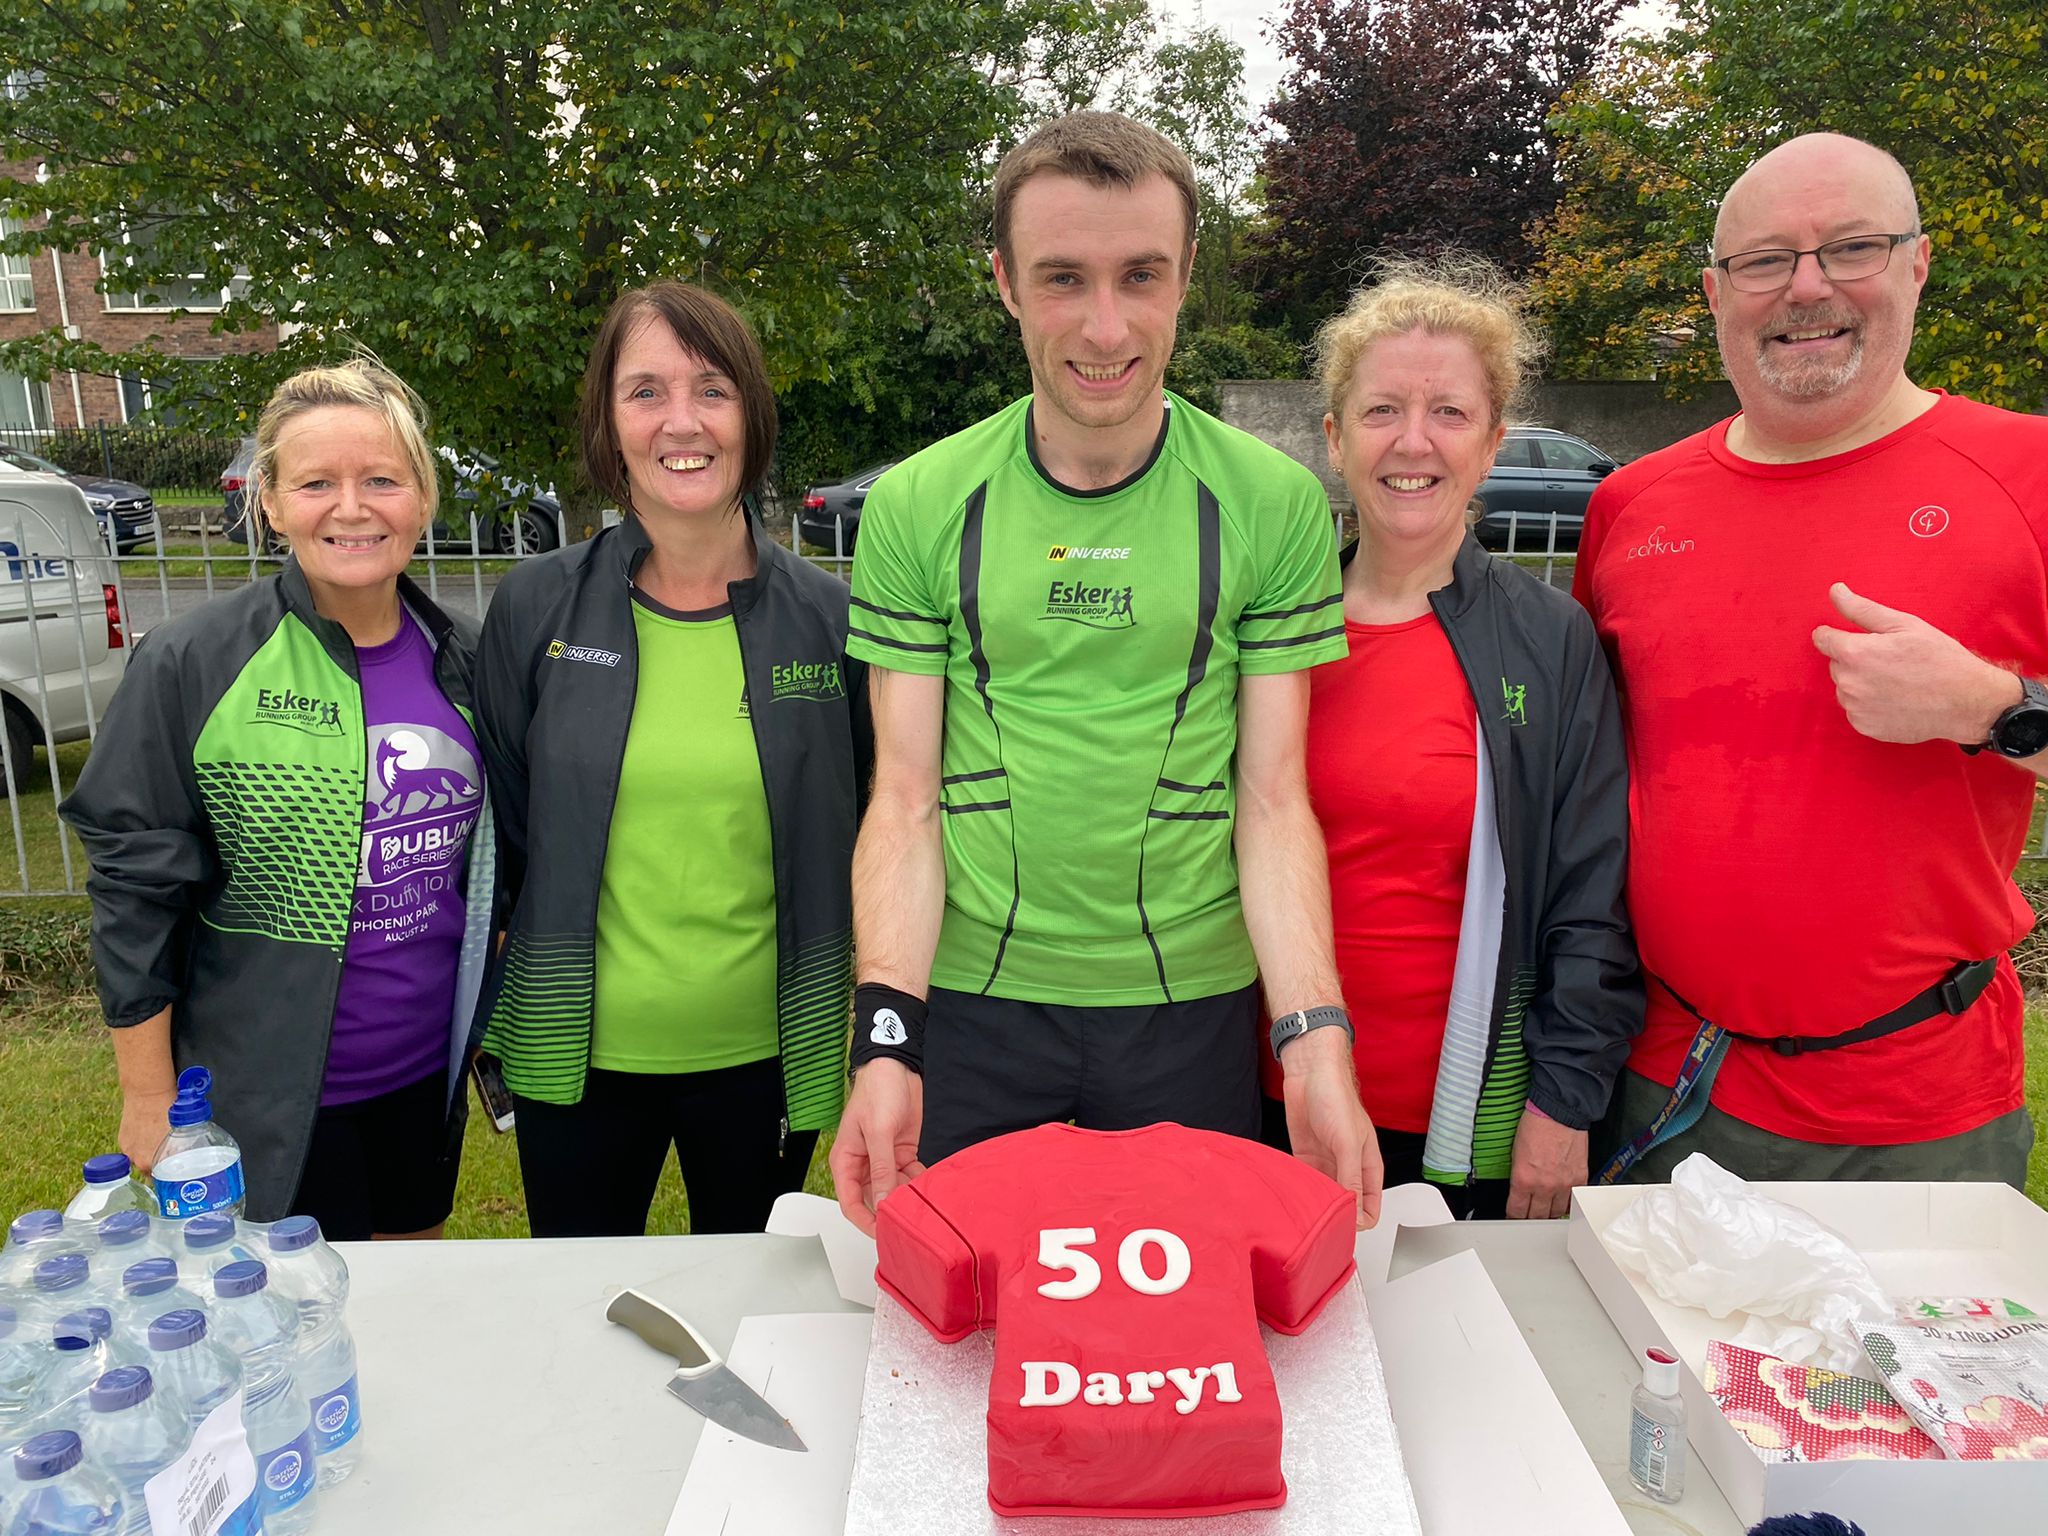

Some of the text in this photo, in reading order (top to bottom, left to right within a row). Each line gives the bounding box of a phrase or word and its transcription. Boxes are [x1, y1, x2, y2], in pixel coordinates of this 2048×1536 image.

[1048, 547, 1132, 559] IN INVERSE
[1626, 526, 1695, 562] parkrun
[1048, 581, 1113, 604] Esker
[1046, 606, 1108, 615] RUNNING GROUP
[566, 648, 618, 665] INVERSE
[772, 660, 822, 686] Esker
[773, 684, 801, 696] RUNNING
[801, 682, 820, 691] GROUP
[257, 689, 320, 712] Esker
[255, 711, 318, 722] RUNNING GROUP
[380, 817, 474, 862] DUBLIN
[383, 848, 452, 876] RACE SERIES
[371, 883, 421, 912] Duffy
[424, 875, 444, 894] 10
[353, 900, 440, 933] PHOENIX PARK
[384, 922, 429, 942] AUGUST 24
[1037, 1227, 1192, 1301] 50
[1919, 1326, 1942, 1339] 30
[1019, 1361, 1243, 1415] Daryl
[320, 1405, 347, 1426] Carrick
[329, 1410, 348, 1426] Glen
[268, 1461, 299, 1482] Carrick
[280, 1467, 299, 1484] Glen
